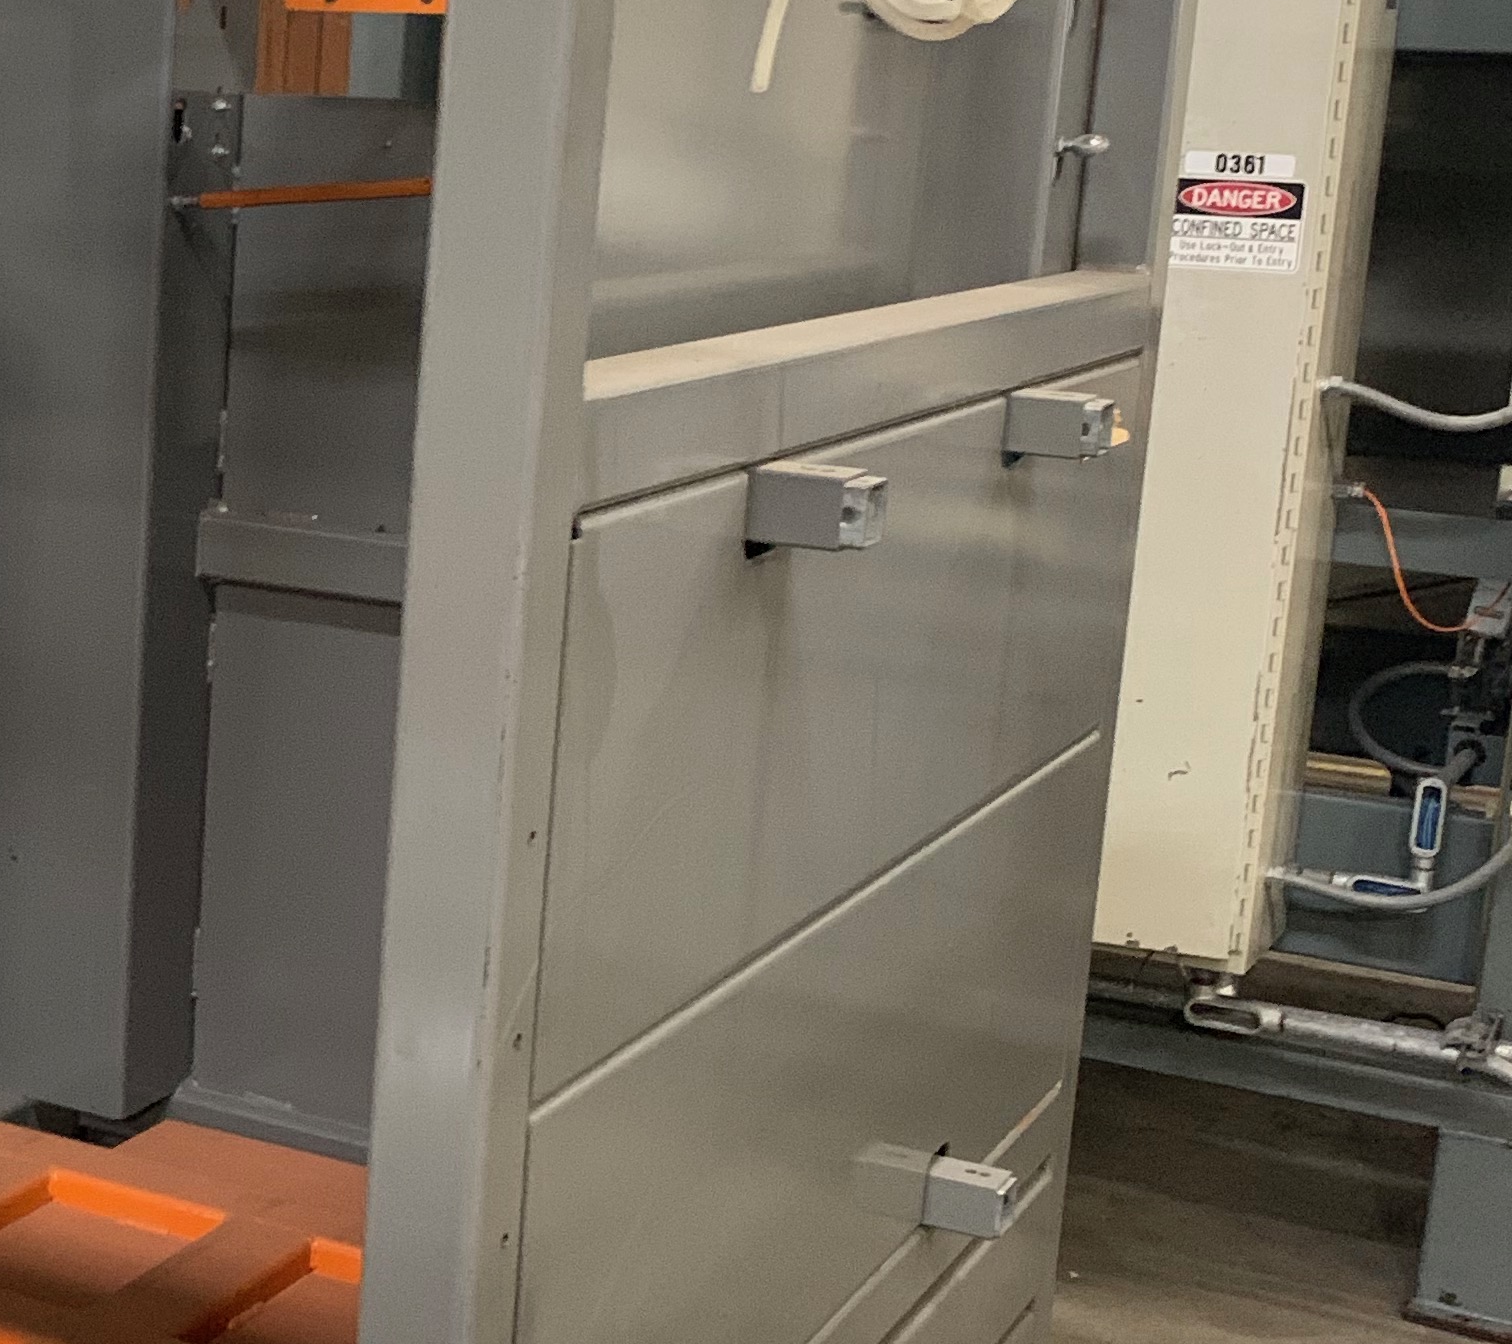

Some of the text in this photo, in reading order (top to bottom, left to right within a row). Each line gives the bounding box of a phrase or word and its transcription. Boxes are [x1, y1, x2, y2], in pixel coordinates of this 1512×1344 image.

[1215, 153, 1266, 174] 0361
[1191, 187, 1283, 210] DANGER
[1172, 218, 1296, 239] CONFINED SPACE
[1179, 240, 1198, 250] Use
[1257, 243, 1284, 259] Entry
[1224, 254, 1247, 265] Prior
[1252, 256, 1263, 266] To
[1266, 256, 1293, 269] Entry
